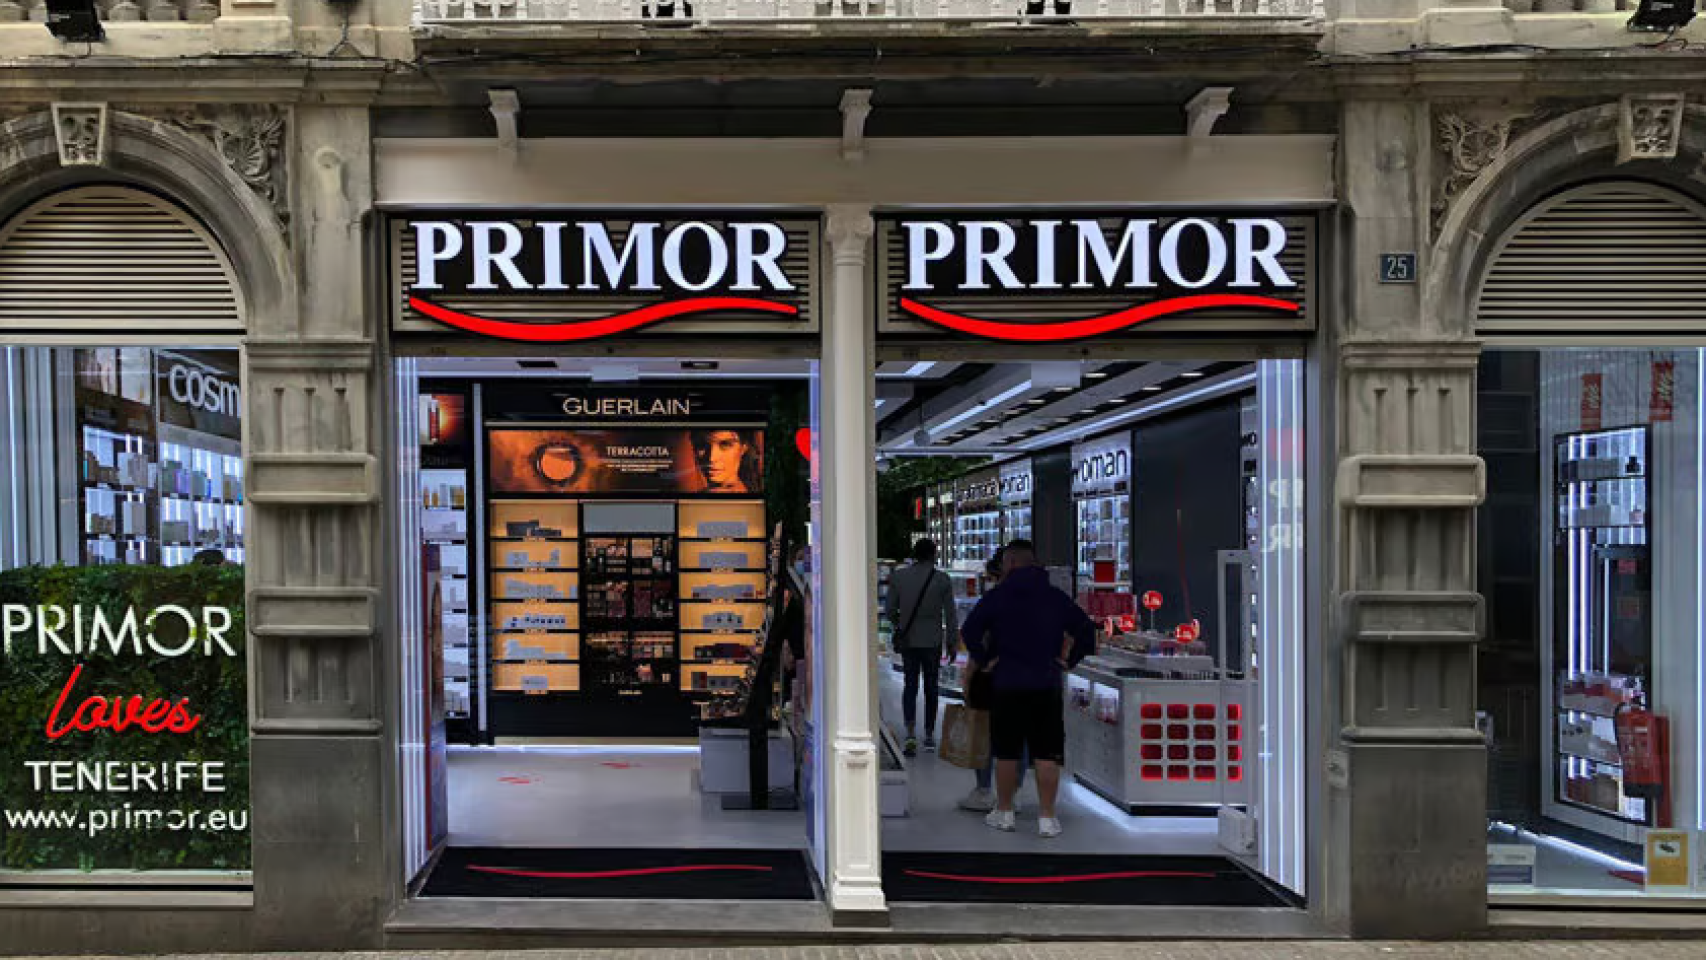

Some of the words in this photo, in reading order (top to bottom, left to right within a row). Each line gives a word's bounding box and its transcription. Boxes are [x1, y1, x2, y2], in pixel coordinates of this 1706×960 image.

[408, 220, 797, 291] PRIMOR
[901, 218, 1298, 290] PRIMOR
[1387, 256, 1407, 279] 25
[562, 397, 690, 415] GUERLAIN
[606, 446, 669, 457] TERRACOTTA
[2, 604, 237, 656] PRIMOR
[24, 760, 226, 792] TENERIFE
[4, 802, 248, 837] www.primor.eu
